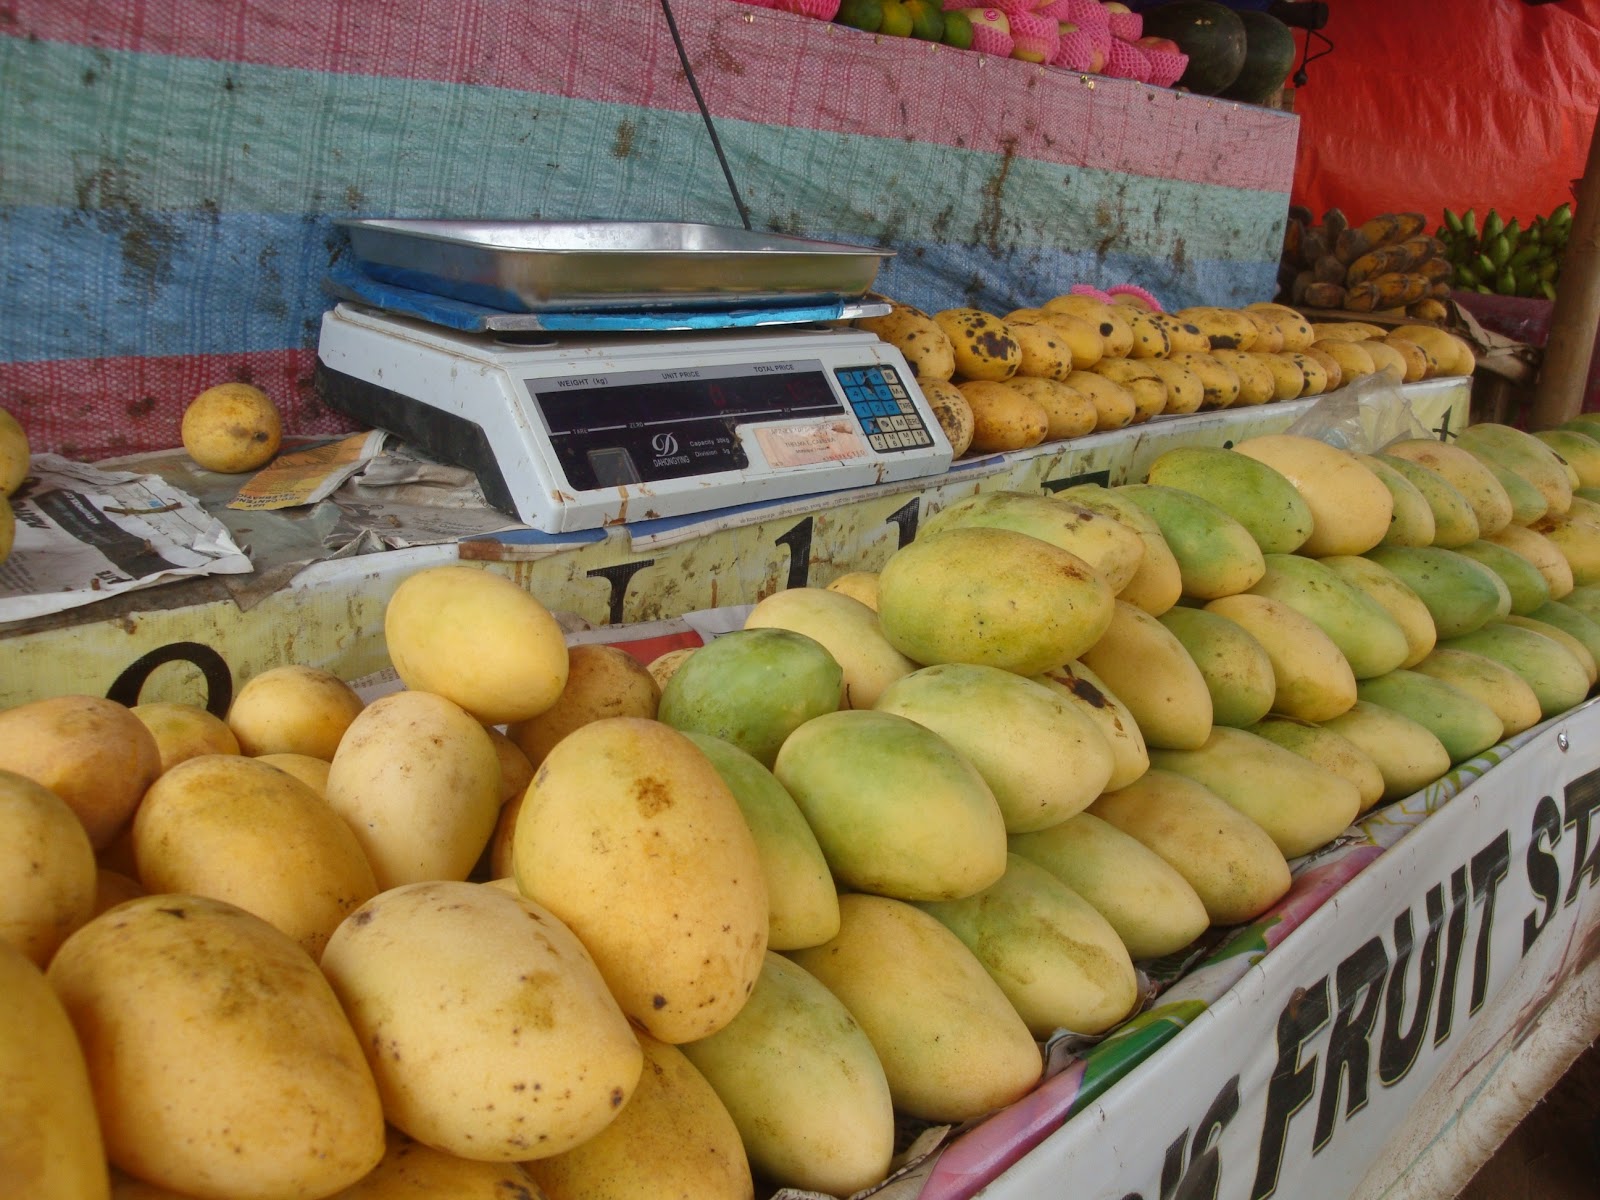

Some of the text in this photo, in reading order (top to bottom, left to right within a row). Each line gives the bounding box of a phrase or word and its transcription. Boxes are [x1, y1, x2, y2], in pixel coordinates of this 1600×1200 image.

[753, 364, 795, 373] TOTAL PRICE
[661, 370, 700, 380] UNIT PRICE
[557, 377, 609, 388] WEIGHT (kg)
[895, 419, 904, 427] M
[689, 439, 715, 447] Capacity
[694, 450, 718, 458] Division
[652, 455, 691, 468] DAHONGYING
[1252, 829, 1511, 1200] FRUIT
